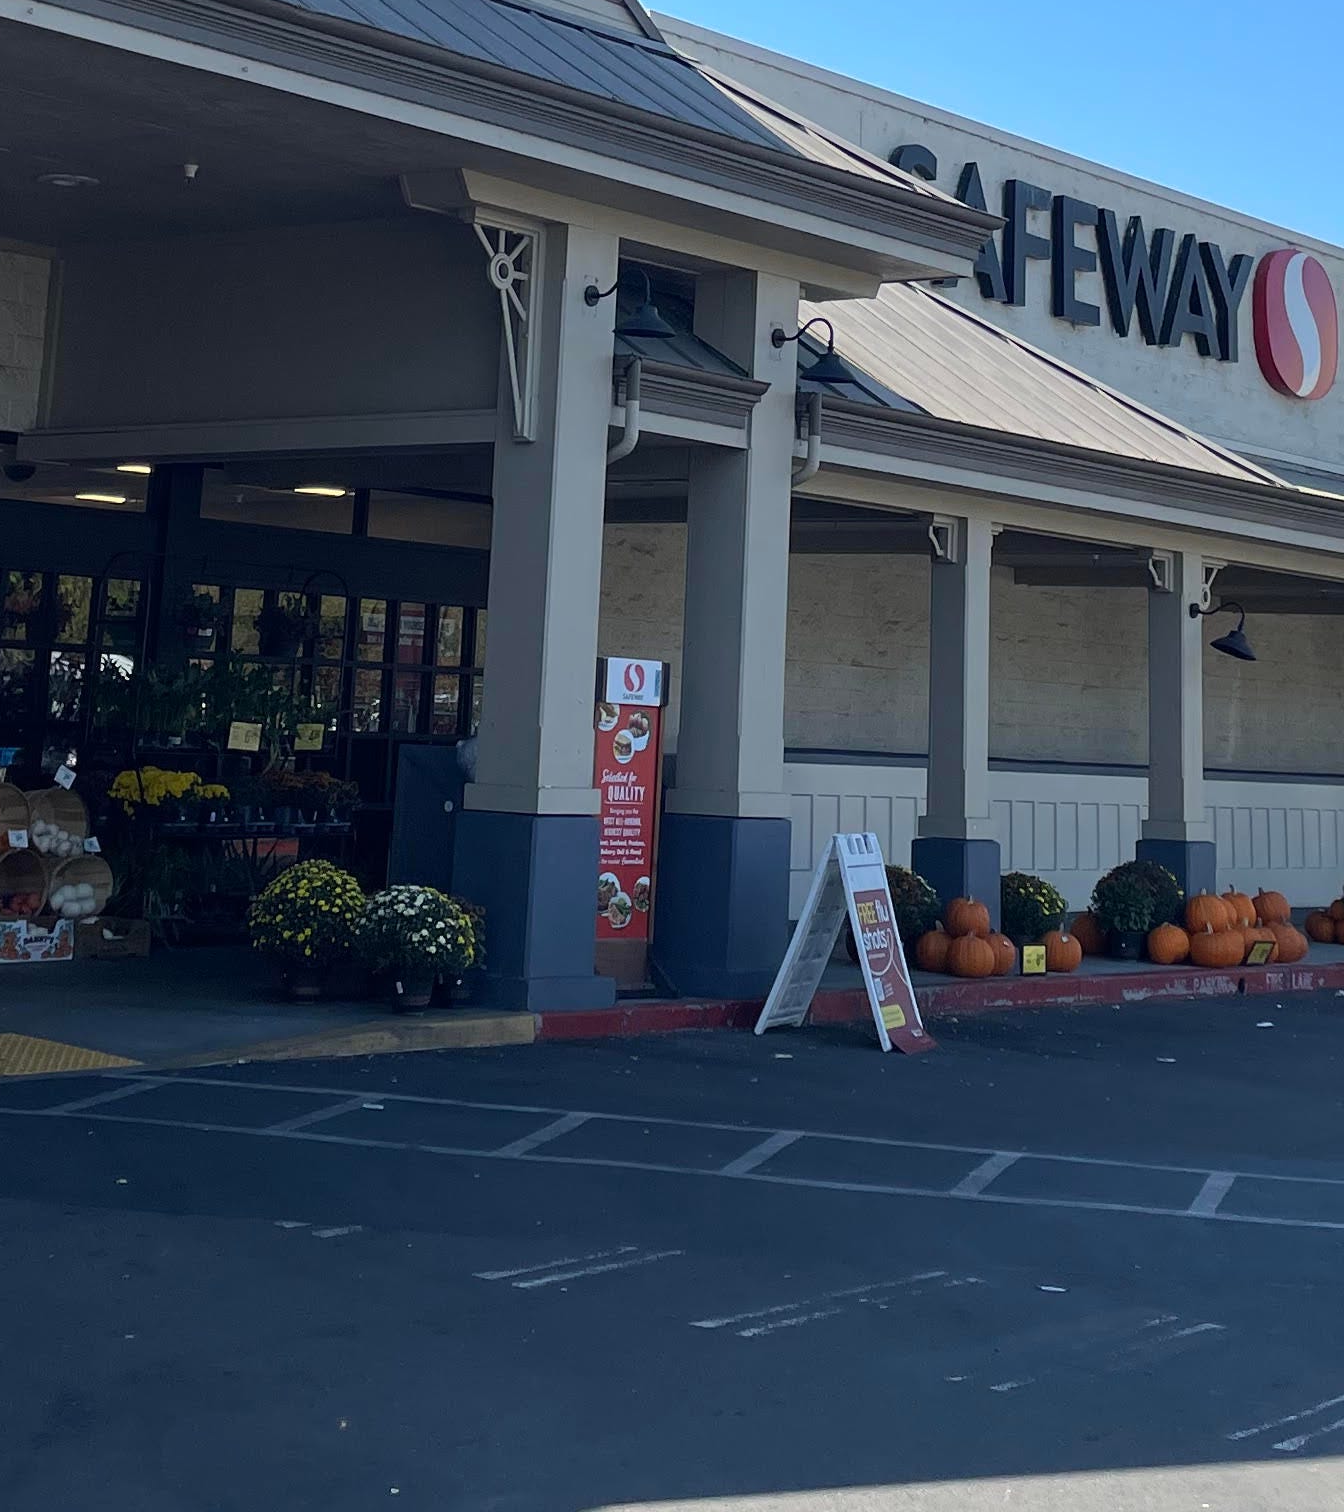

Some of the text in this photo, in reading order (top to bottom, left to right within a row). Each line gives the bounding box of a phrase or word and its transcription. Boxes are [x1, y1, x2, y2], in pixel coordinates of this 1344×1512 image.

[608, 785, 645, 802] QUALITY
[857, 898, 890, 925] FREE flu
[863, 927, 888, 951] shots
